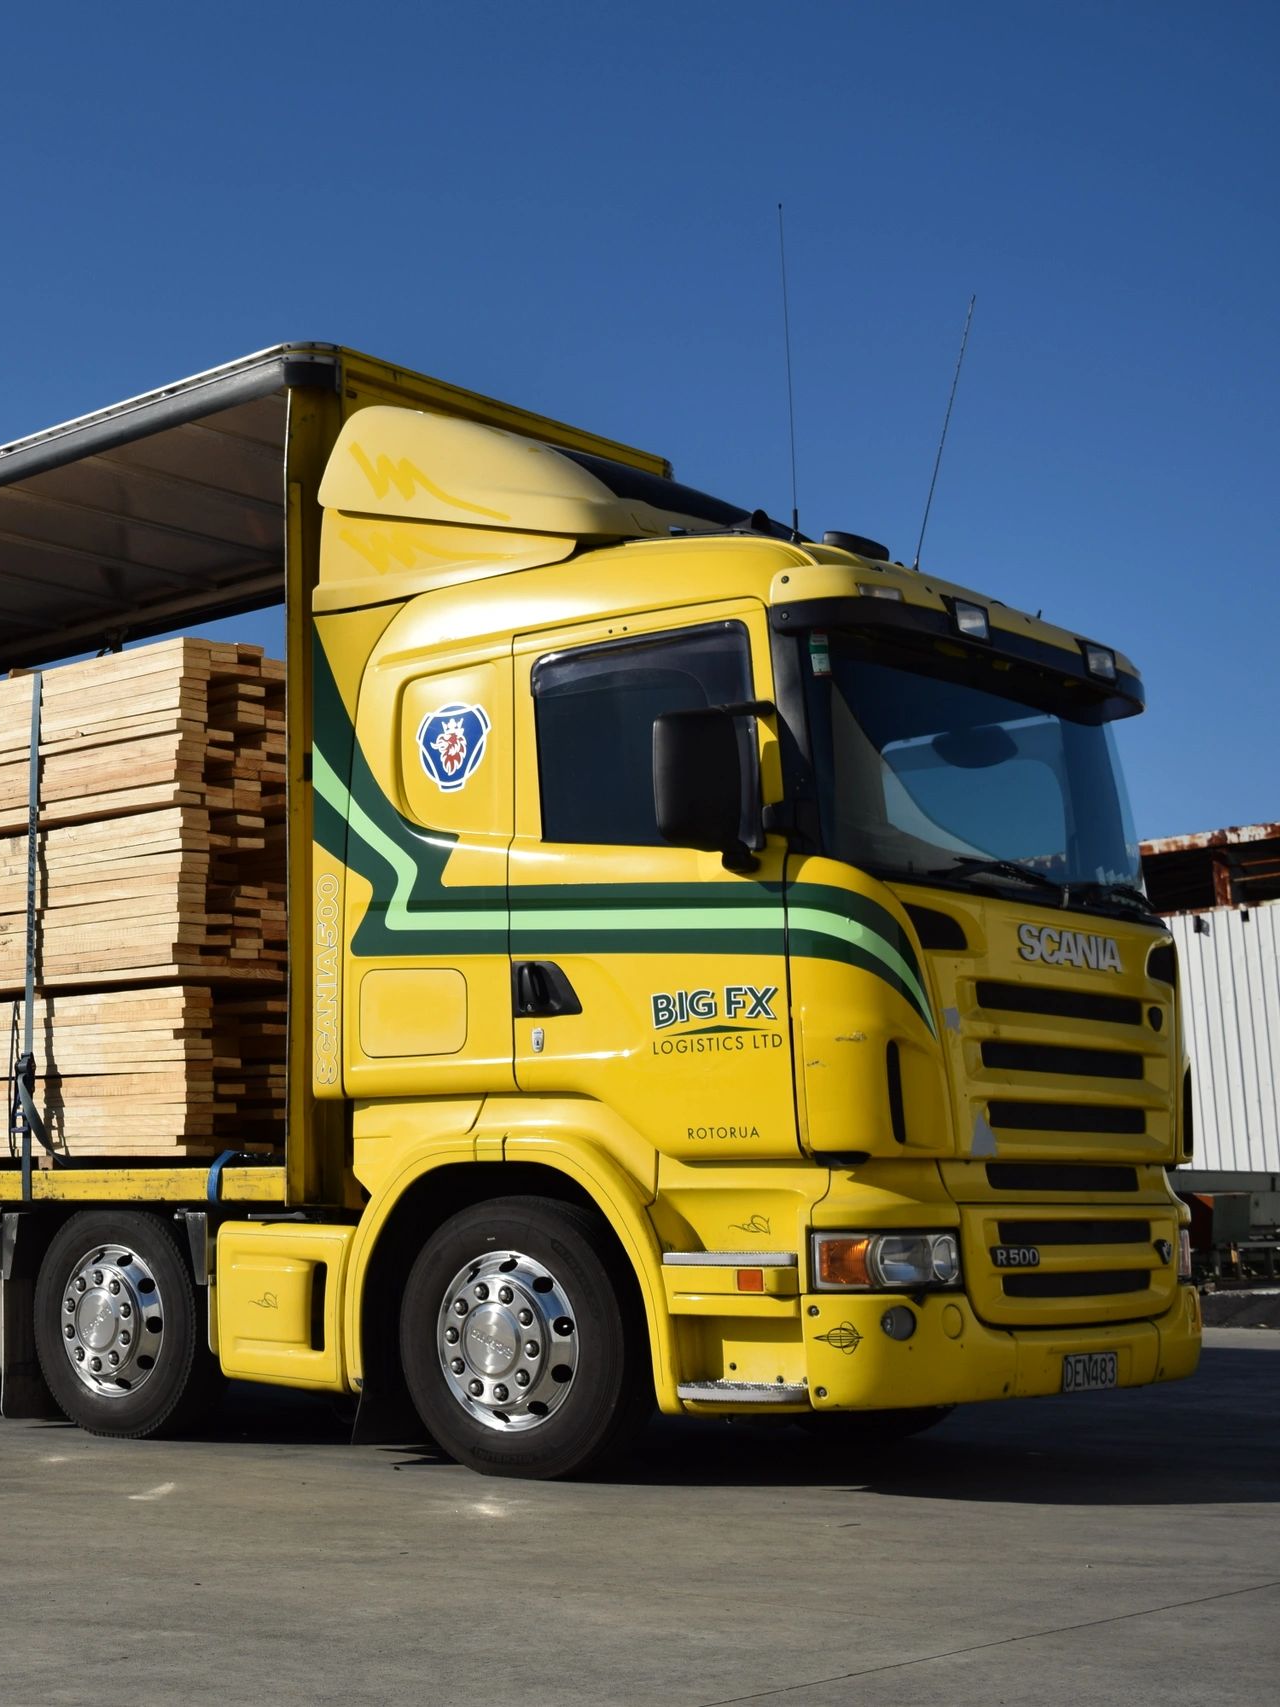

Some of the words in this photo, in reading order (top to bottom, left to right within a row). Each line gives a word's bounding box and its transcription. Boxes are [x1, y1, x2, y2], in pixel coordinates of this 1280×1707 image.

[1018, 923, 1124, 973] SCANIA
[651, 988, 717, 1030] BIG
[724, 985, 778, 1020] FX
[652, 1035, 744, 1055] LOGISTICS
[752, 1033, 783, 1049] LTD
[687, 1126, 760, 1140] ROTORUA
[1064, 1356, 1116, 1387] DEN483
